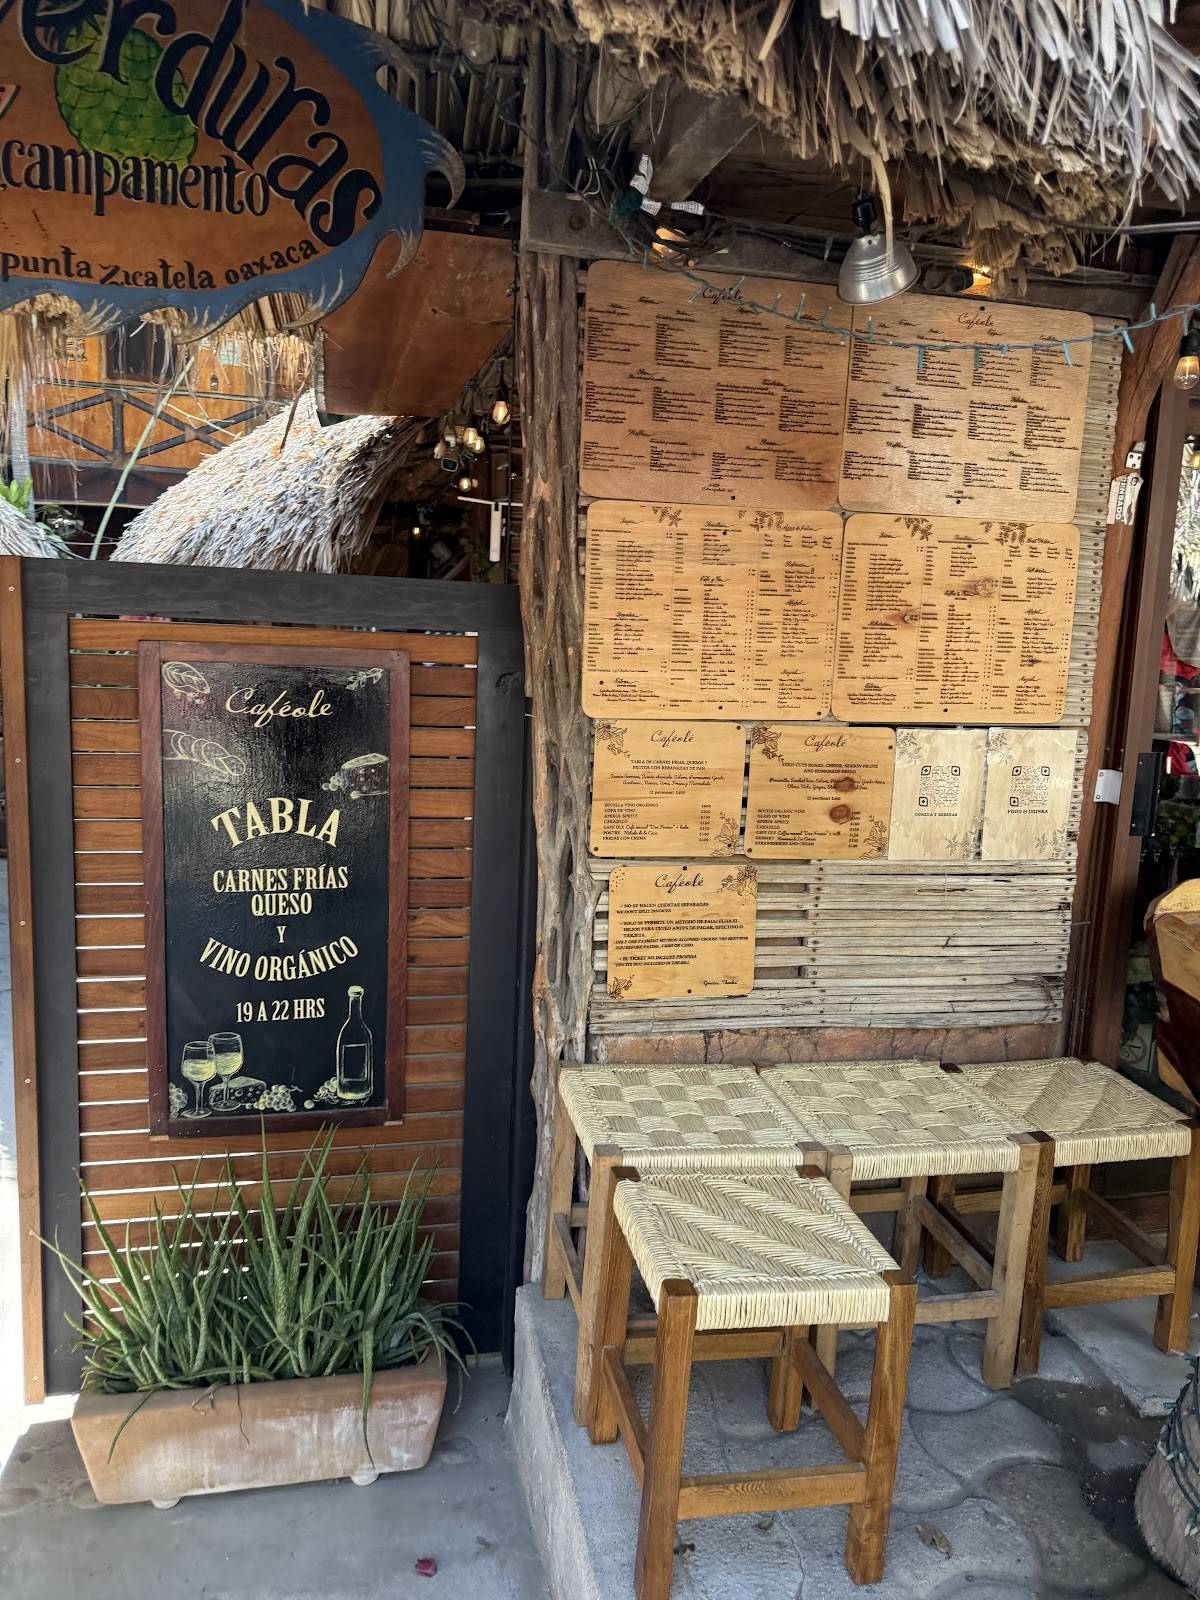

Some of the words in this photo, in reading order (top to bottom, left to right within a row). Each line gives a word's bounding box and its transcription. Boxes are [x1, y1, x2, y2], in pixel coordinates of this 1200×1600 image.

[2, 140, 269, 216] campamento
[2, 245, 93, 278] punta
[225, 239, 319, 285] oaxaca
[210, 797, 340, 848] TABLA
[213, 868, 288, 892] CARNES
[293, 864, 348, 890] FRÍAS
[251, 892, 312, 916] QUESO
[277, 926, 286, 943] Y
[200, 937, 250, 978] VINO
[254, 935, 358, 981] ORGÁNICO
[236, 1003, 252, 1022] 19
[257, 1002, 267, 1021] A
[272, 1000, 289, 1020] 22
[293, 998, 325, 1019] HRS
